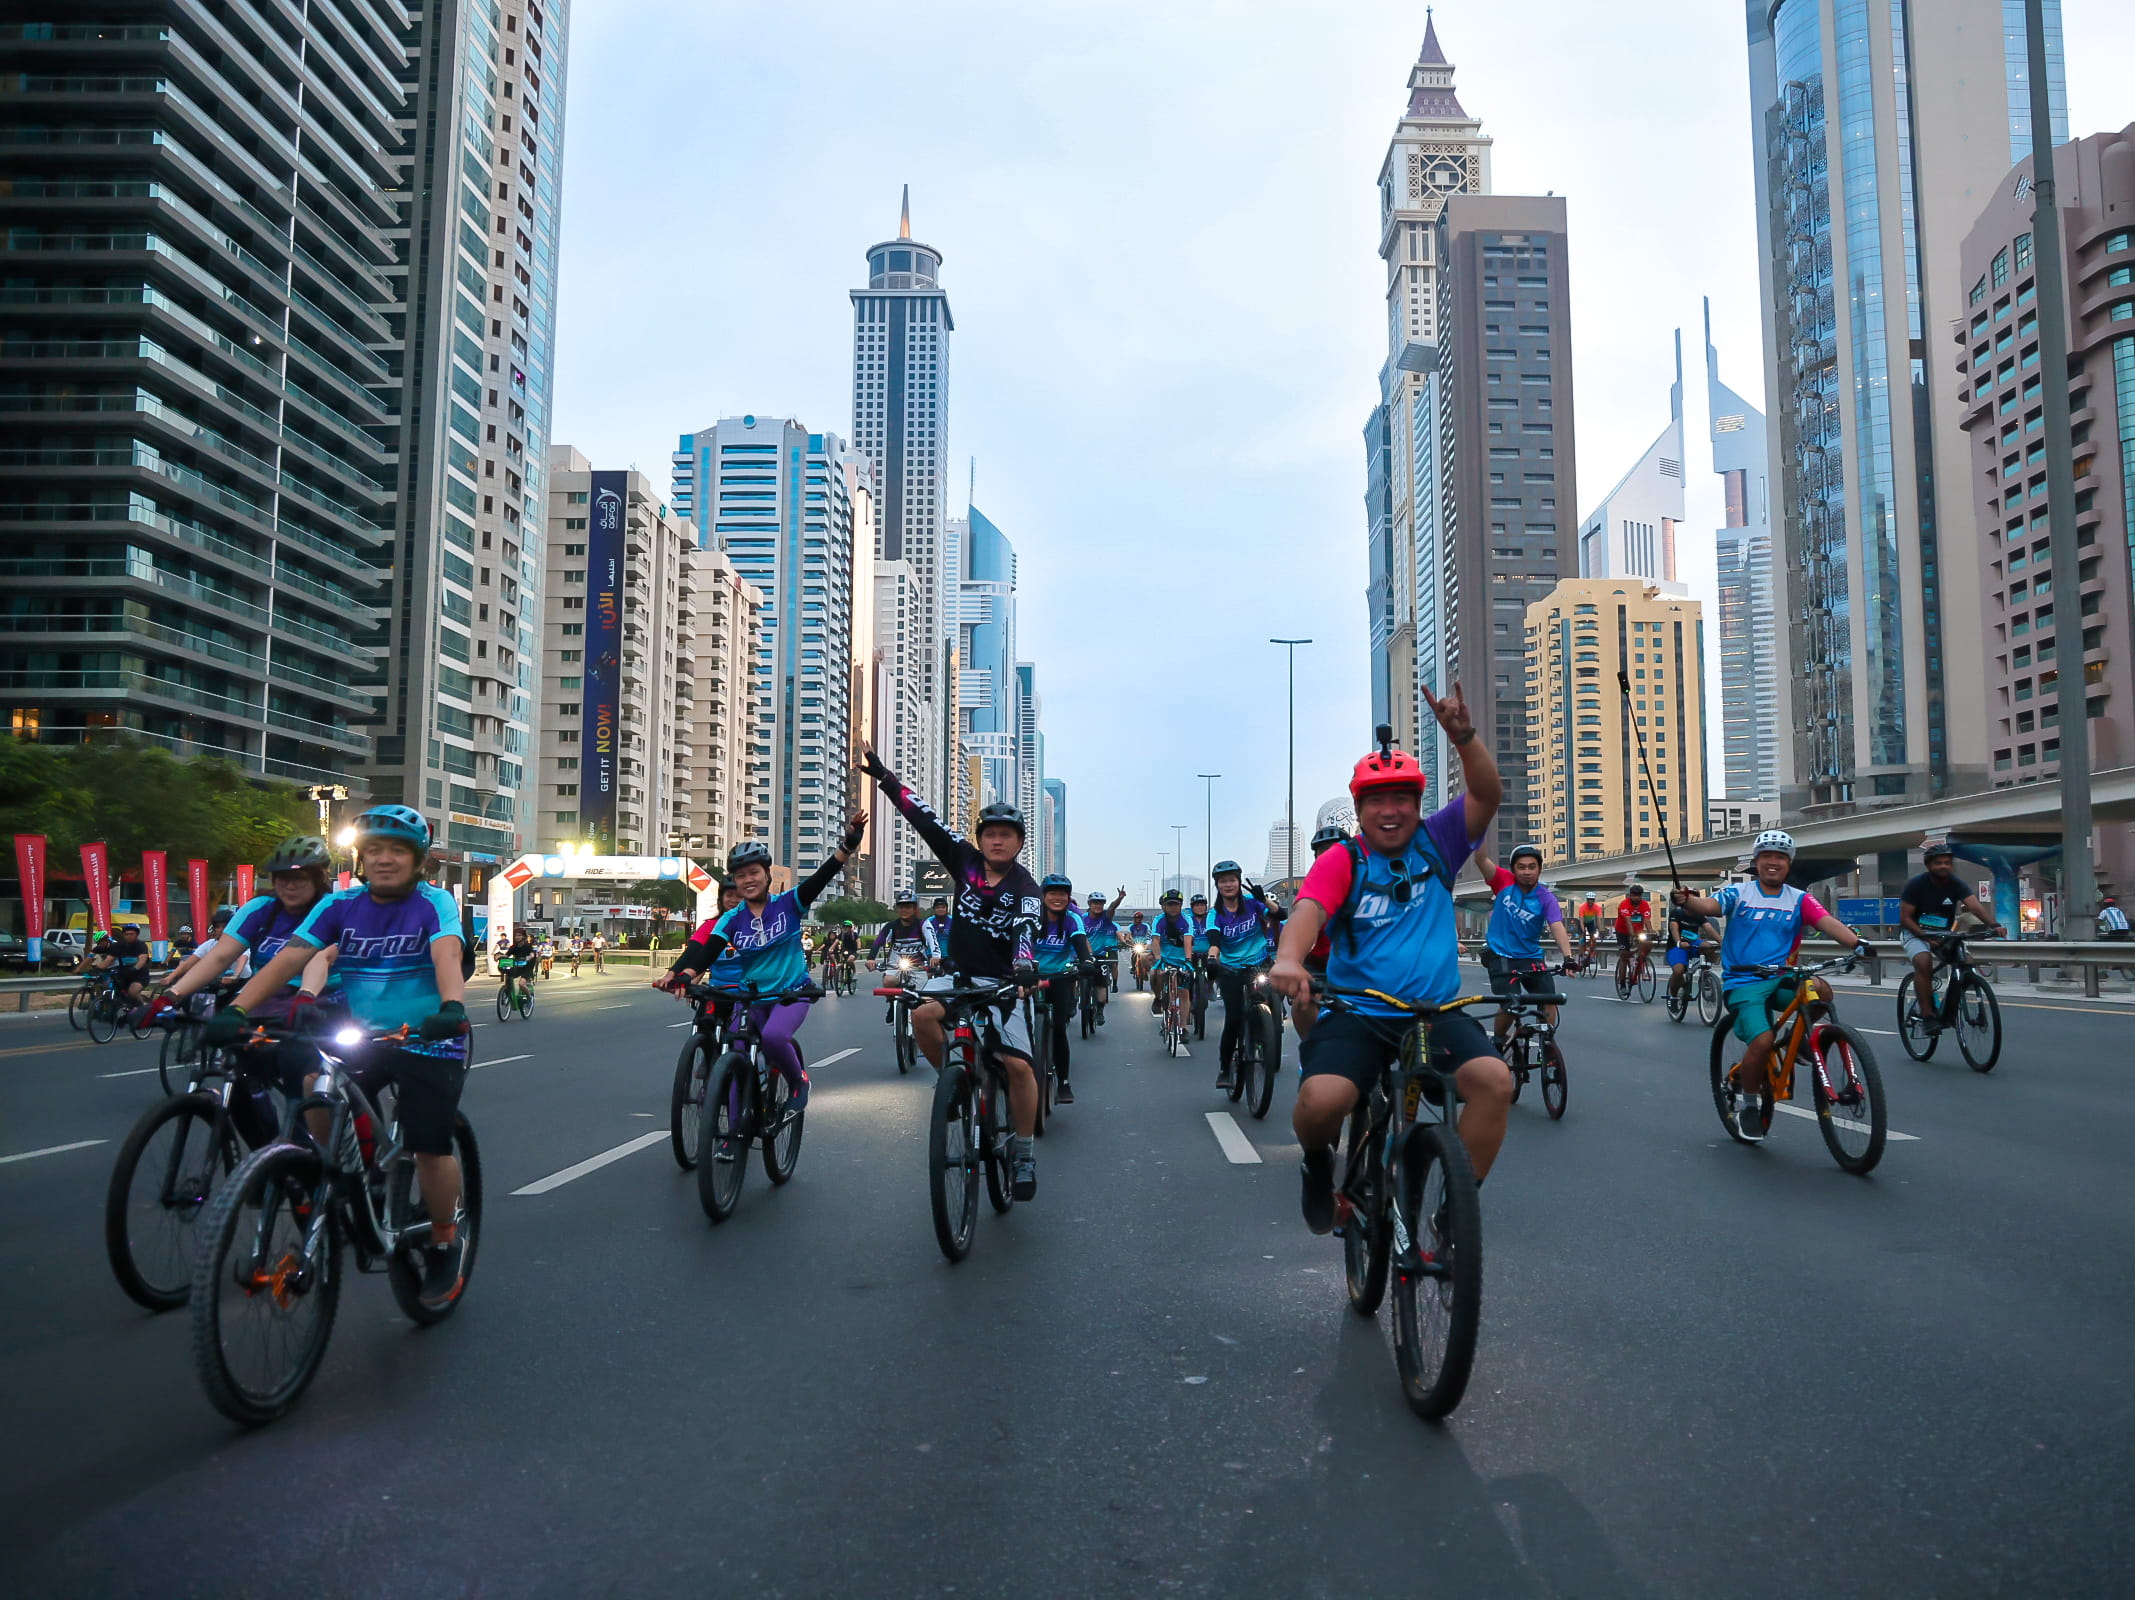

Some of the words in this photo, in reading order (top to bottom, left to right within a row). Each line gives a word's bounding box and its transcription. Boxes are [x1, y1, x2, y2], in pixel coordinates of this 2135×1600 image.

[596, 704, 613, 753] NOW!
[601, 757, 610, 768] IT
[600, 770, 609, 792] GET
